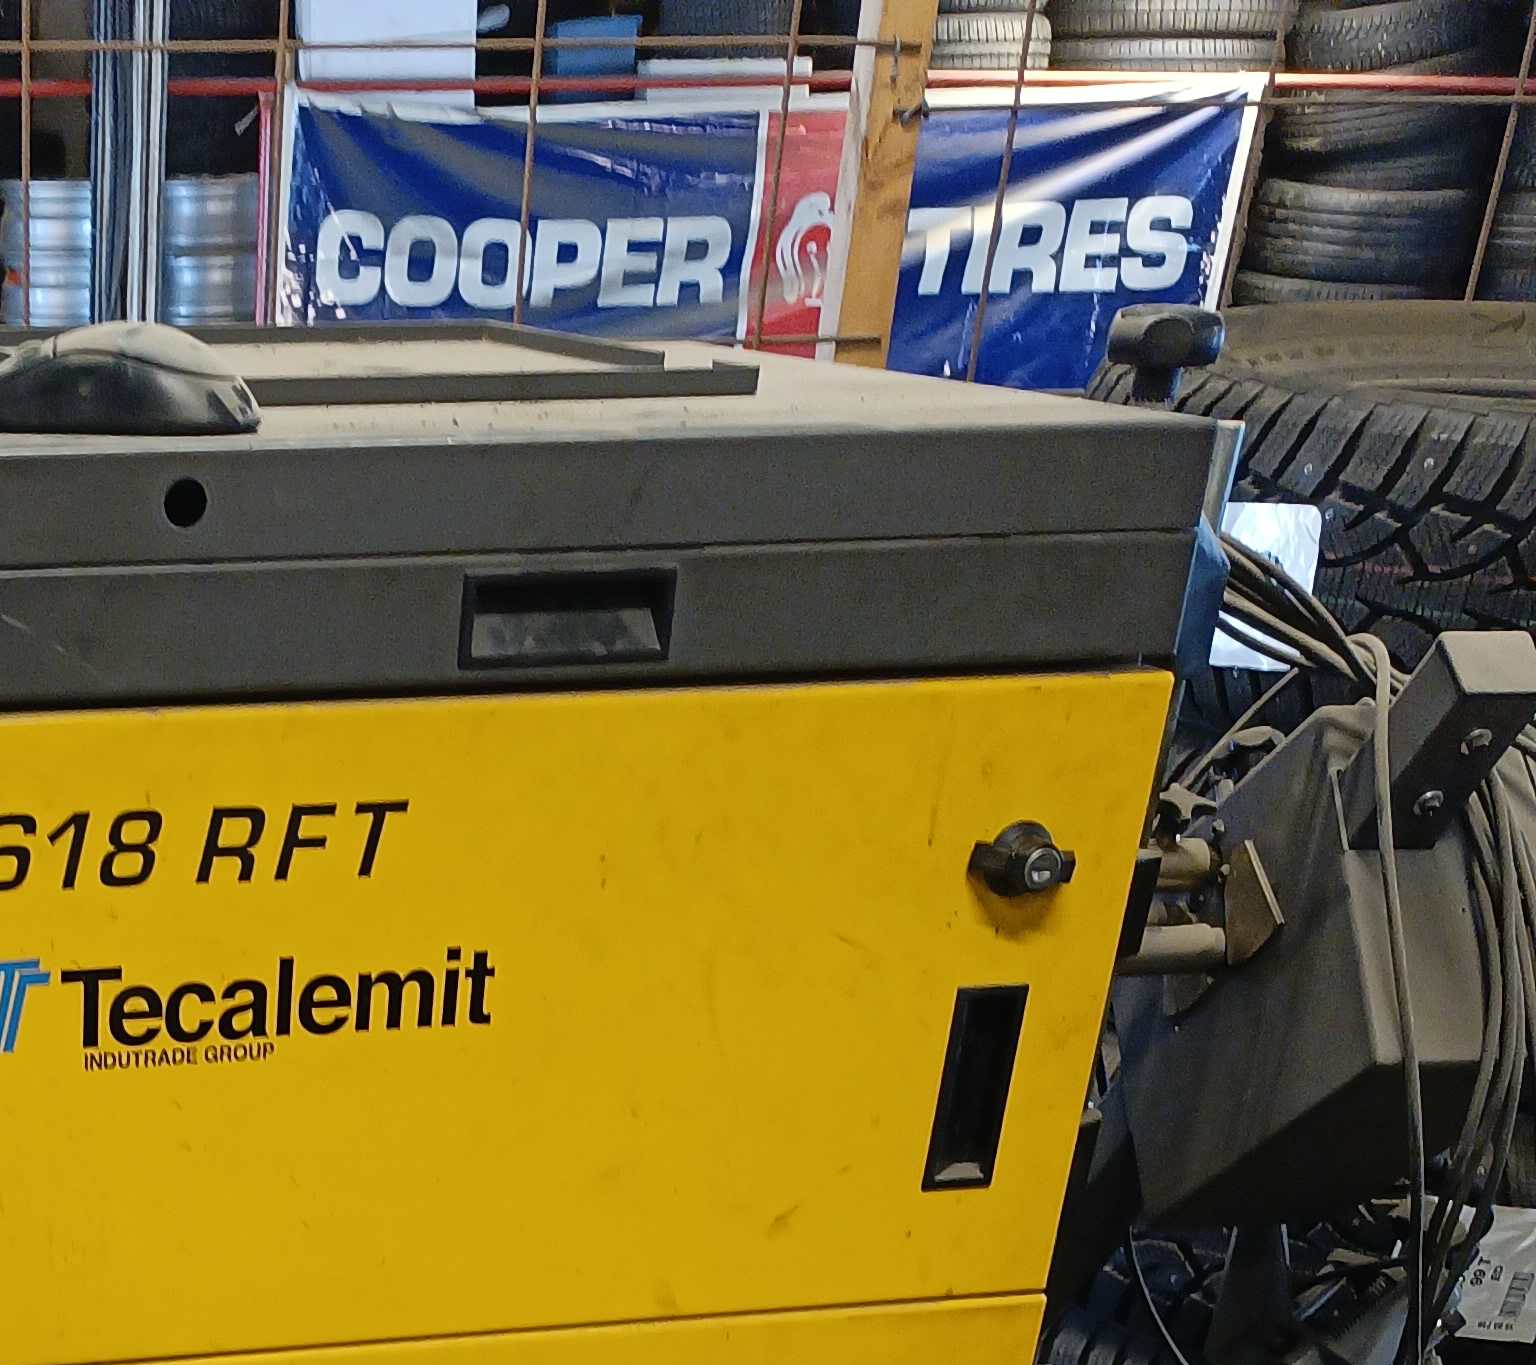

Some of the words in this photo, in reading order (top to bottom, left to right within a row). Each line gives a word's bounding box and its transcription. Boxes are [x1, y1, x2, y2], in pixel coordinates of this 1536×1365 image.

[316, 208, 734, 311] COOPER
[906, 194, 1195, 298] TIRES
[194, 799, 410, 886] RFT
[60, 946, 496, 1048] Tecalemit
[83, 1046, 198, 1072] INDUTRADE
[203, 1041, 276, 1066] GROUP
